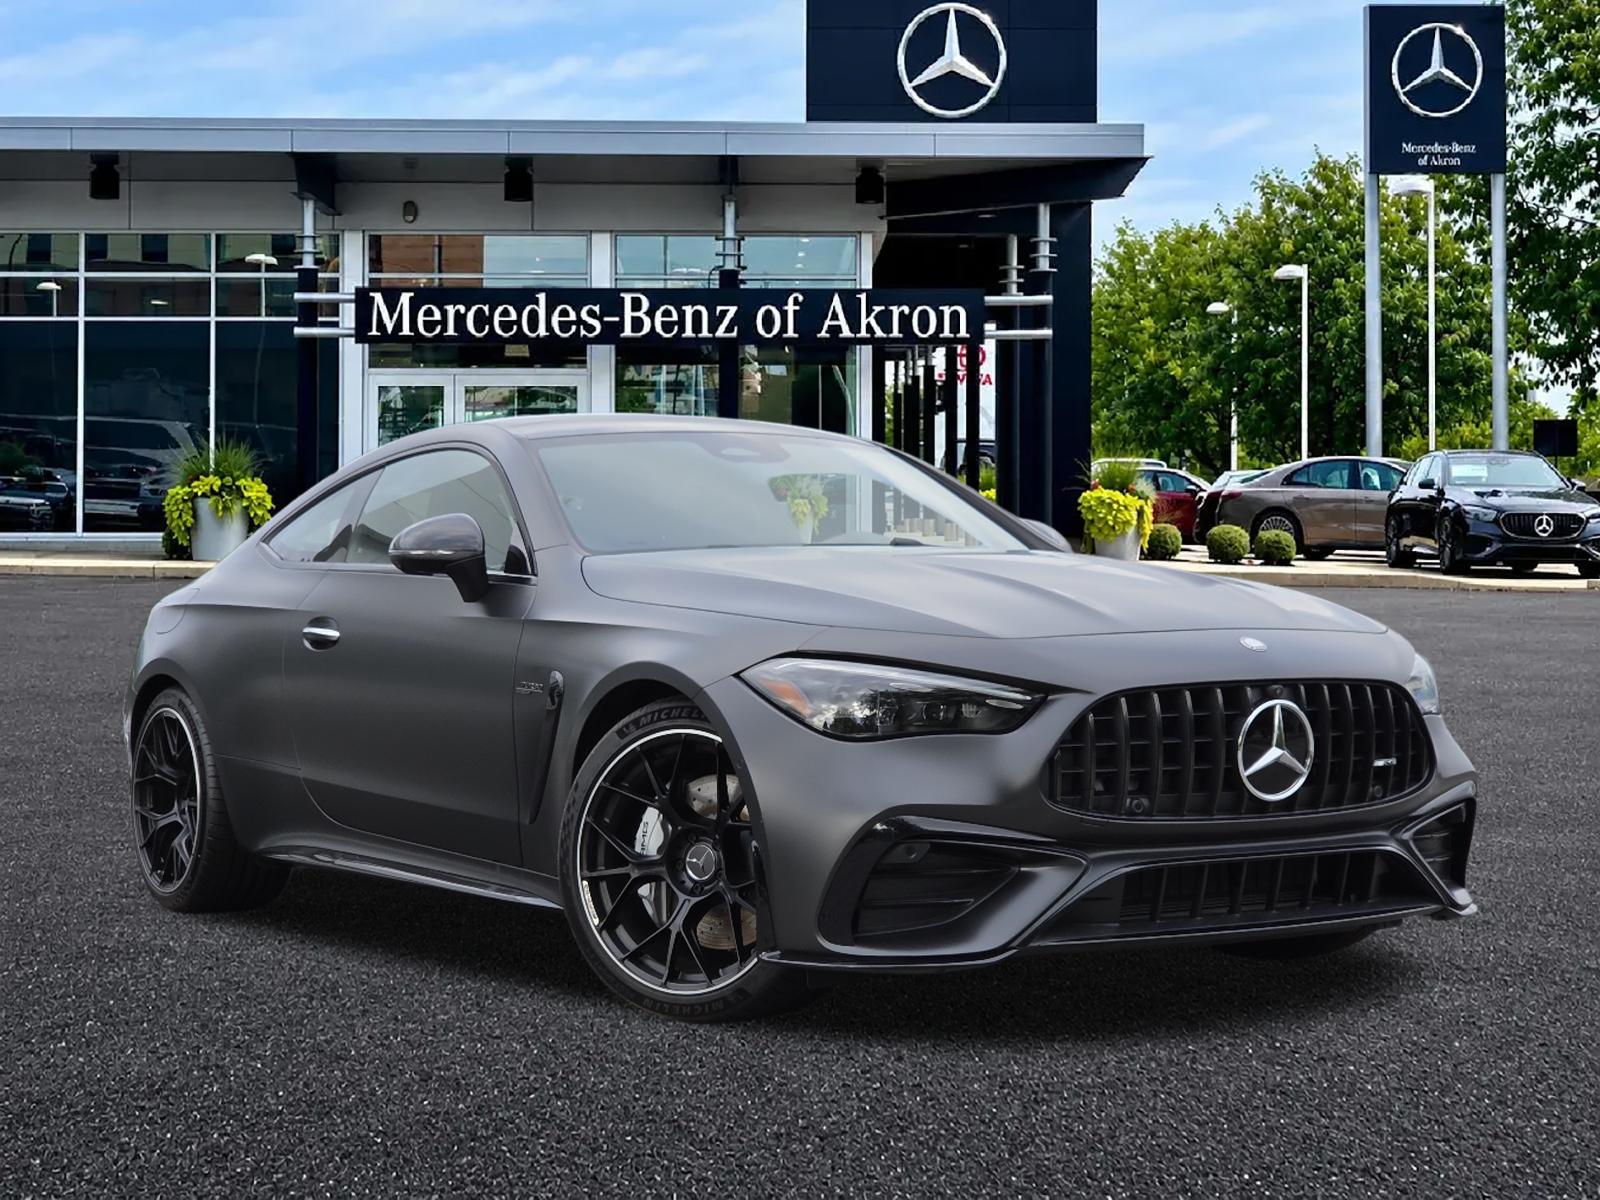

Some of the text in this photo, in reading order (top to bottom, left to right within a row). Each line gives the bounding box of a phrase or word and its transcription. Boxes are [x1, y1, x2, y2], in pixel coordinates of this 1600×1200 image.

[1401, 142, 1476, 154] Mercedes-Benz
[1417, 154, 1461, 167] of Akron
[367, 291, 970, 339] Mercedes-Benz of Akron
[640, 707, 705, 727] MICHEL
